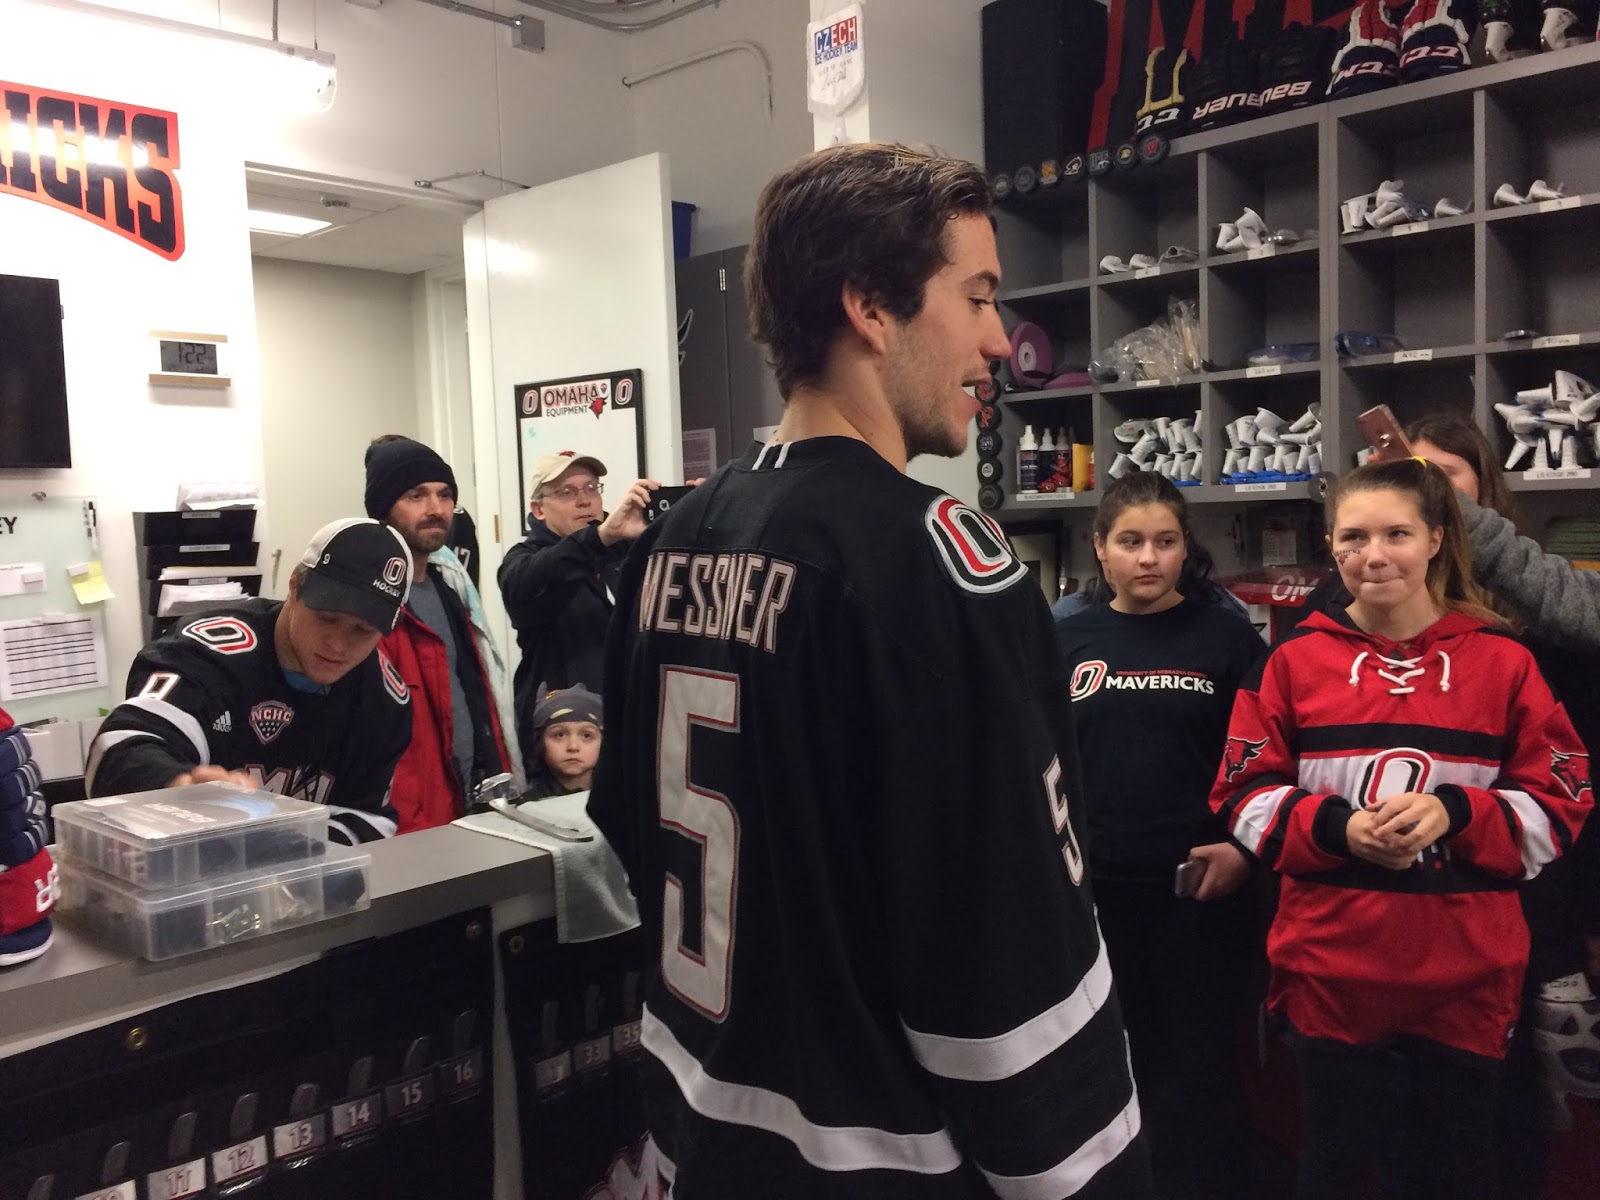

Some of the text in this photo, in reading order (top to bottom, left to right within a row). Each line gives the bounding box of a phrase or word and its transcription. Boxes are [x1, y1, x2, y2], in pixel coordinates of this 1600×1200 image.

[815, 17, 858, 54] CZECH
[823, 46, 843, 62] HOCKEY
[844, 40, 858, 54] TEAM
[0, 88, 176, 254] ICKS
[543, 383, 599, 408] OMAHA
[546, 405, 588, 417] EQUIPMENT
[322, 553, 331, 565] 9
[372, 579, 402, 598] HOCKEY
[1105, 674, 1215, 695] MAVERICKS
[251, 708, 292, 721] NCHC
[1043, 754, 1084, 886] 5
[656, 664, 741, 1024] 5
[454, 1061, 473, 1083] 16
[401, 1082, 423, 1106] 15
[348, 1102, 370, 1127] 14
[289, 1123, 313, 1149] 13
[228, 1144, 255, 1172] 12
[166, 1168, 190, 1194] 11
